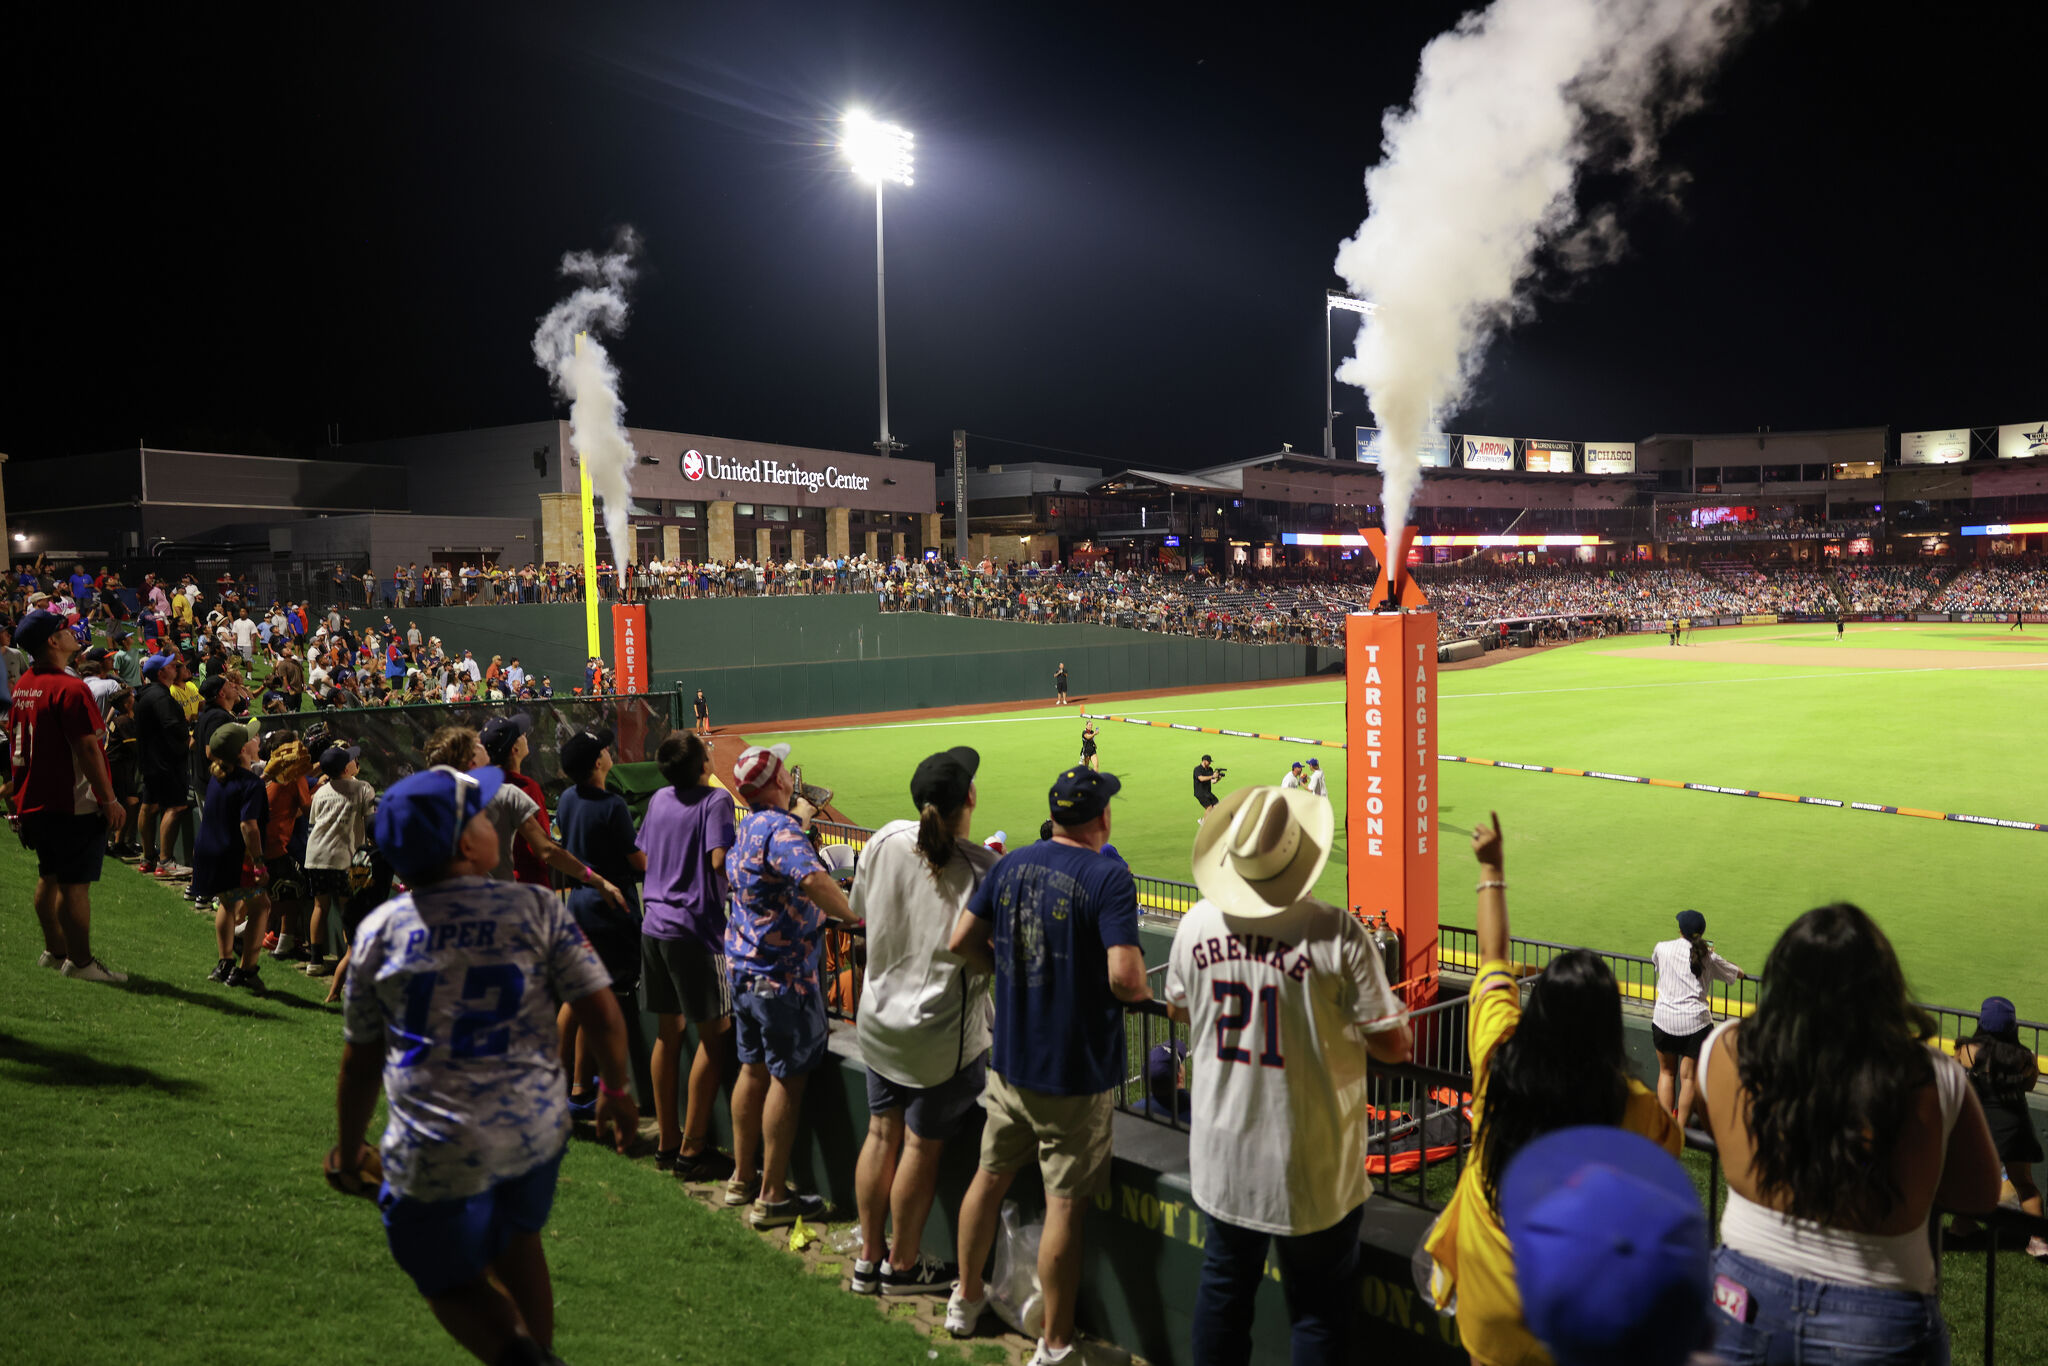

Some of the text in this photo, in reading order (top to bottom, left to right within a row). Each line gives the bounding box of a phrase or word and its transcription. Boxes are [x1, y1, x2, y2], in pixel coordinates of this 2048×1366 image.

[705, 454, 870, 494] United Heritage Center
[1479, 442, 1506, 455] ARROW
[1598, 451, 1632, 461] CHASCO
[625, 618, 635, 674] TARGET
[1365, 645, 1384, 857] TARGET ZONE
[1416, 643, 1428, 855] TARGET ZONE
[405, 920, 497, 955] PIPER
[1192, 934, 1312, 983] GREINKE
[397, 963, 525, 1068] 12
[1212, 979, 1285, 1069] 21
[1121, 1184, 1179, 1238] NOT
